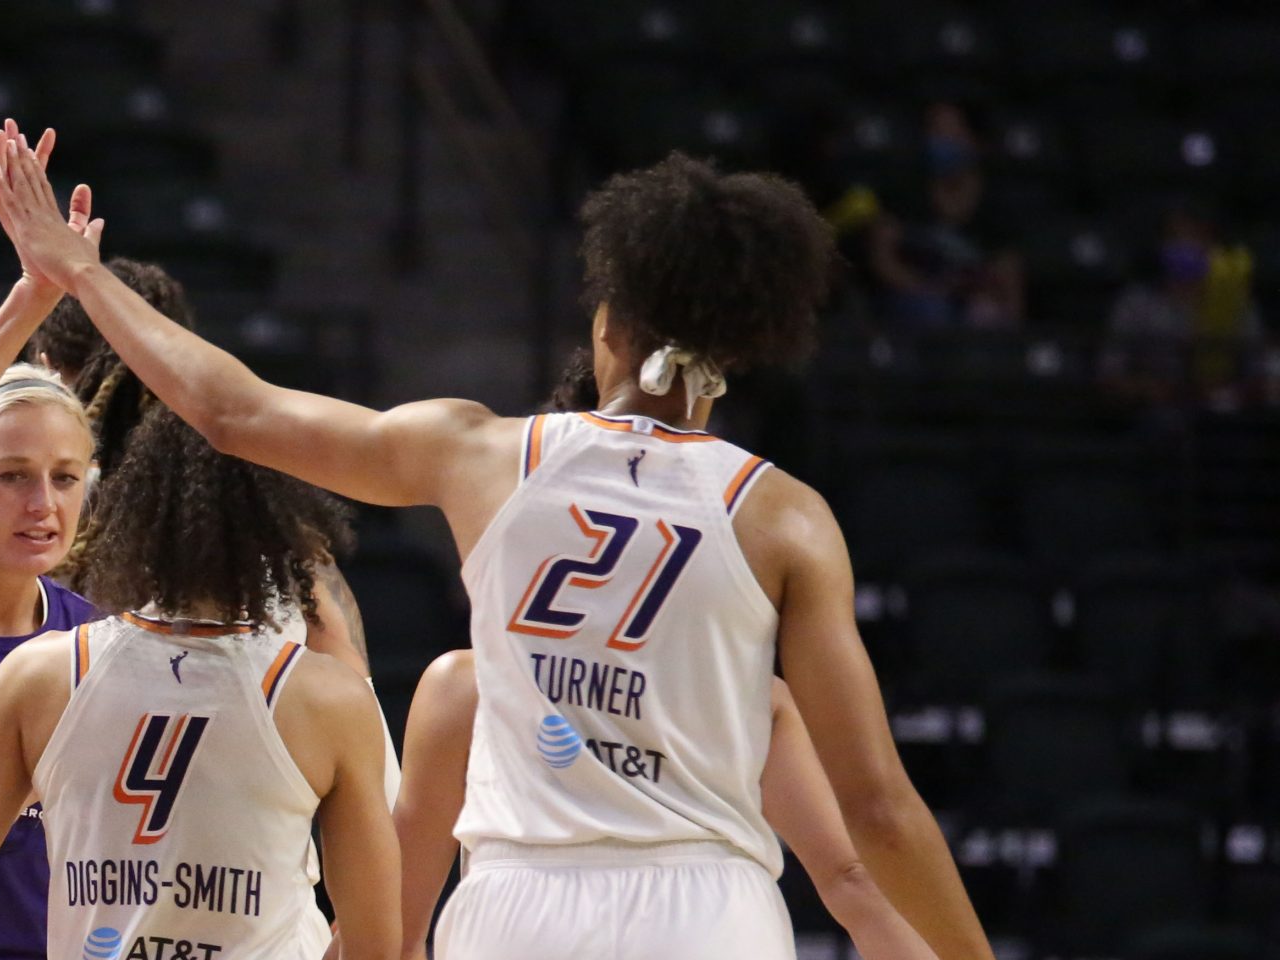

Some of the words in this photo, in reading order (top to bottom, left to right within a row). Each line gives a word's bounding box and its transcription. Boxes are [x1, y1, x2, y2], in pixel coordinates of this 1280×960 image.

[506, 502, 703, 651] 21
[530, 652, 646, 720] TURNER
[112, 711, 213, 845] 4
[66, 859, 262, 917] DIGGINS-SMITH
